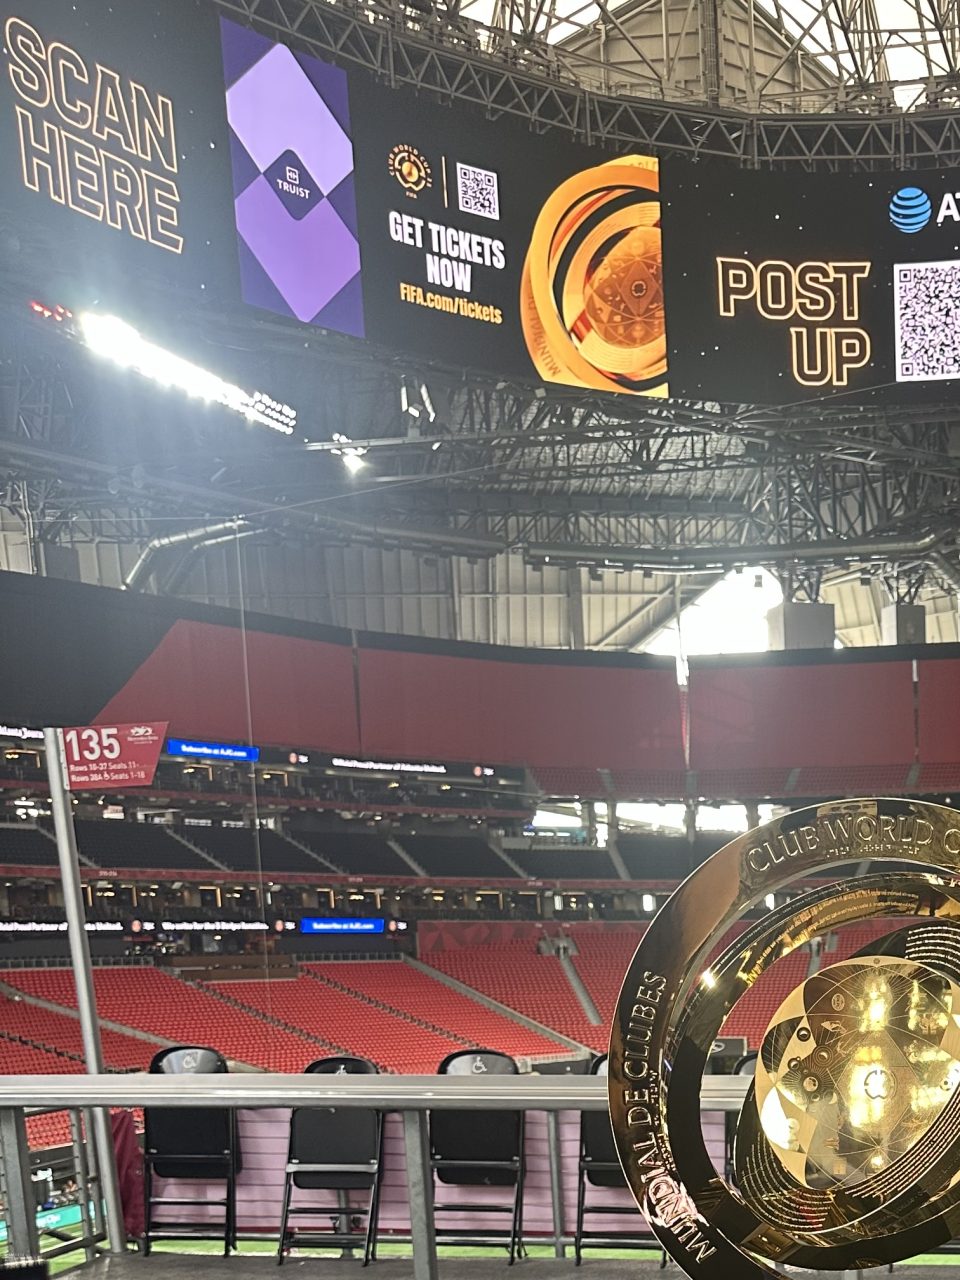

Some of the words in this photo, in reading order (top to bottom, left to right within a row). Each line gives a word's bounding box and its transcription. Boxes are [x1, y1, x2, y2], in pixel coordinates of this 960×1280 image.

[4, 16, 177, 174] SCAN
[15, 106, 184, 254] HERE
[277, 178, 310, 199] TRUIST
[389, 210, 424, 248] GET
[428, 221, 506, 270] TICKETS
[425, 253, 472, 293] NOW
[716, 257, 871, 322] POST
[400, 282, 503, 325] FIFA.com/tickets
[790, 327, 871, 386] UP
[66, 727, 121, 761] 135
[69, 764, 88, 772] Rows
[108, 762, 127, 770] Seats
[70, 774, 89, 782] Rows
[110, 772, 129, 780] Seats
[748, 826, 820, 872] CLUB
[823, 815, 934, 845] WORLD
[623, 971, 667, 1080] CLUBES
[624, 1089, 651, 1128] DE
[633, 1133, 717, 1264] MUNDIAL
